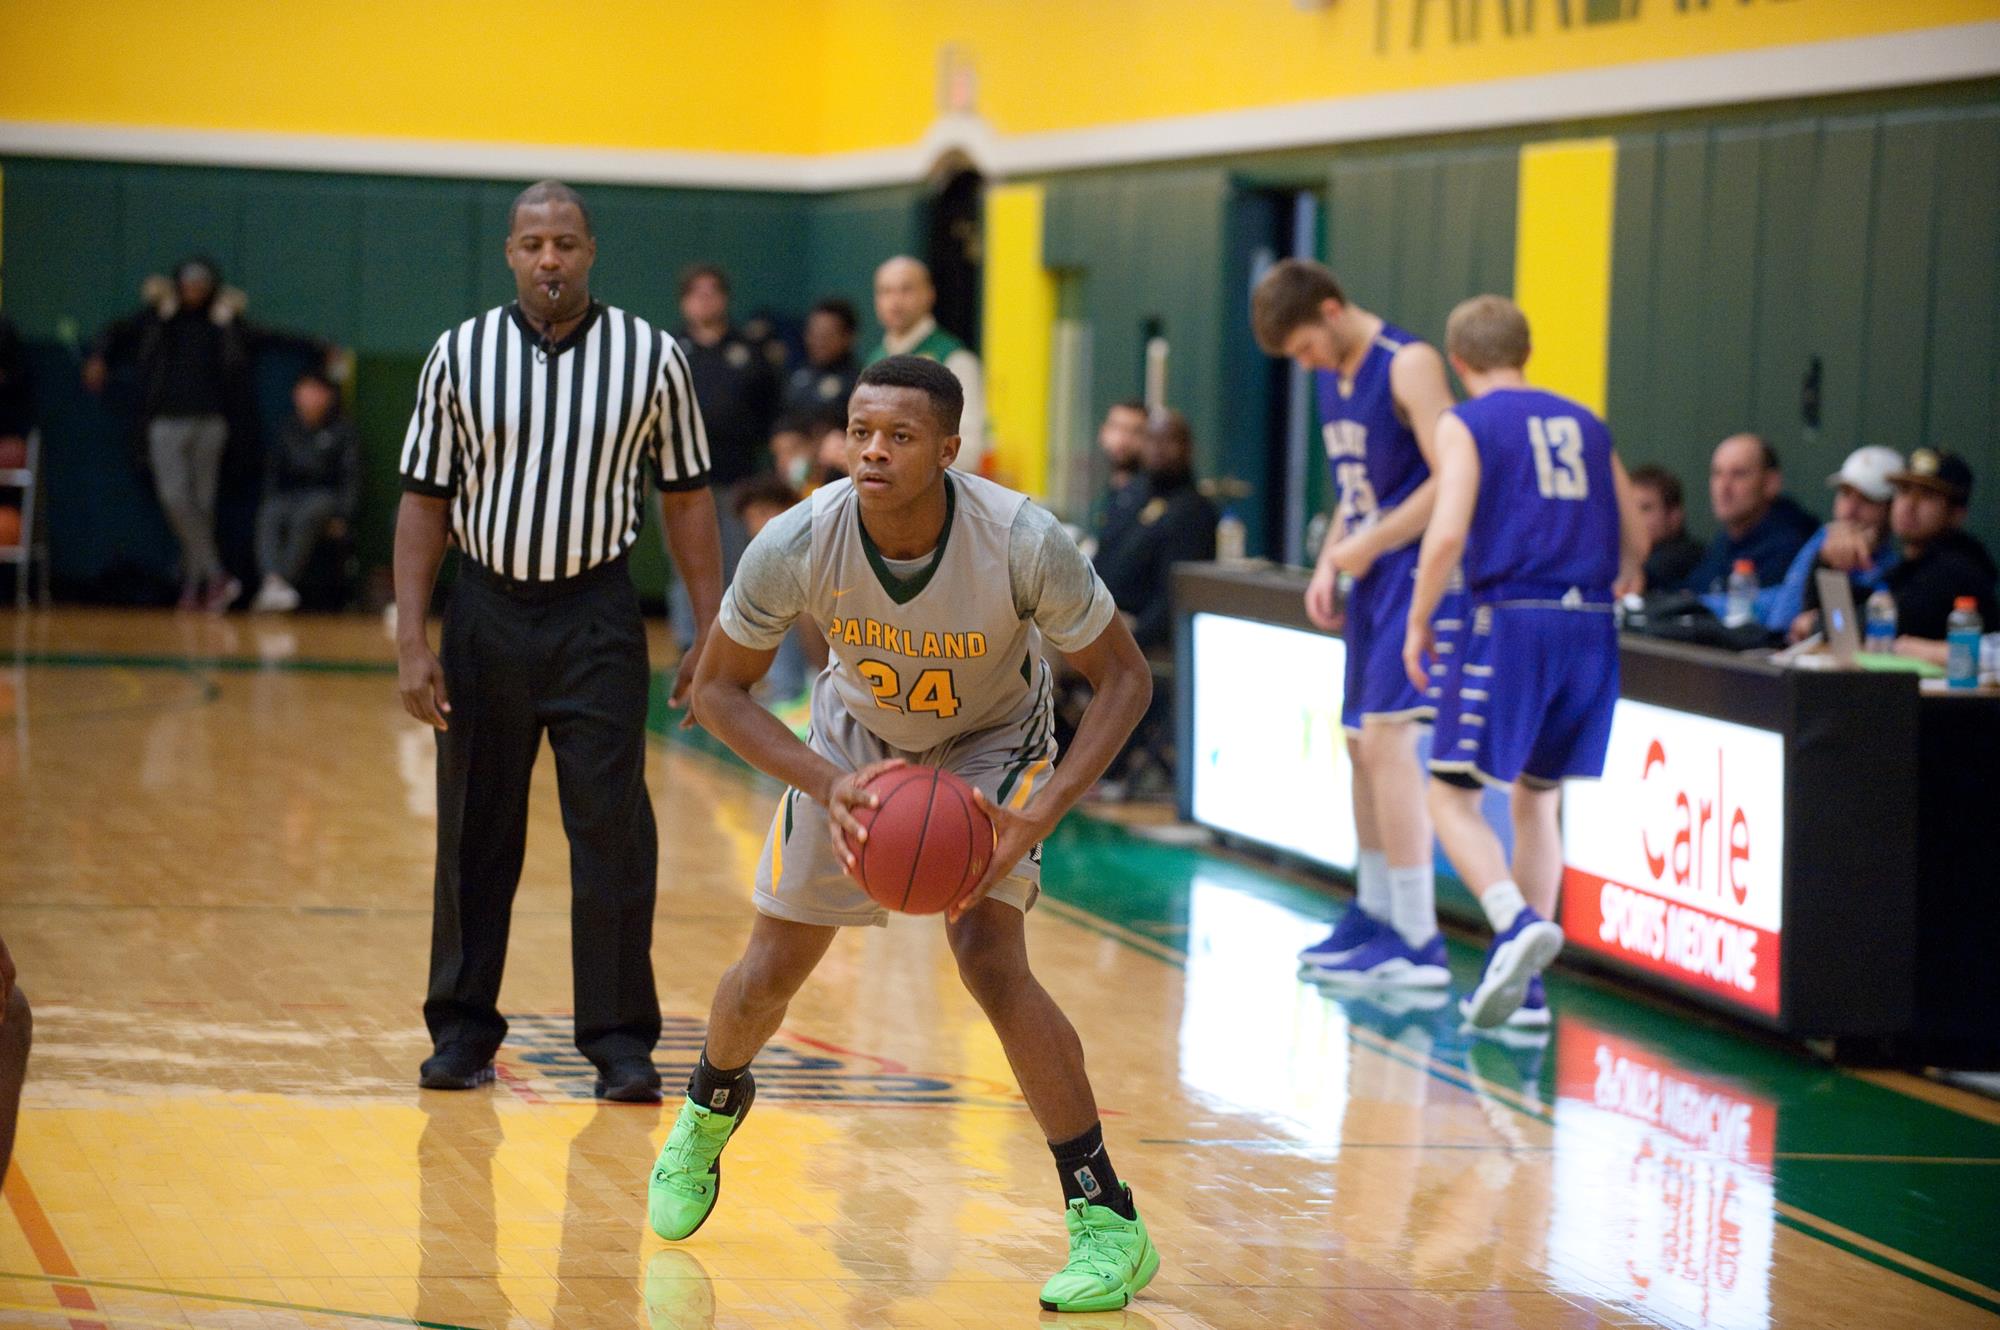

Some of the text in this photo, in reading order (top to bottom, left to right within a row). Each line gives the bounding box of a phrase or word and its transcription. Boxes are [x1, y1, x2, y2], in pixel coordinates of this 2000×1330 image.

[1527, 415, 1590, 501] 13
[829, 616, 988, 660] PARKLAND
[857, 658, 962, 719] 24
[1642, 739, 1751, 906] Carle
[1665, 904, 1757, 992] MEDICINE
